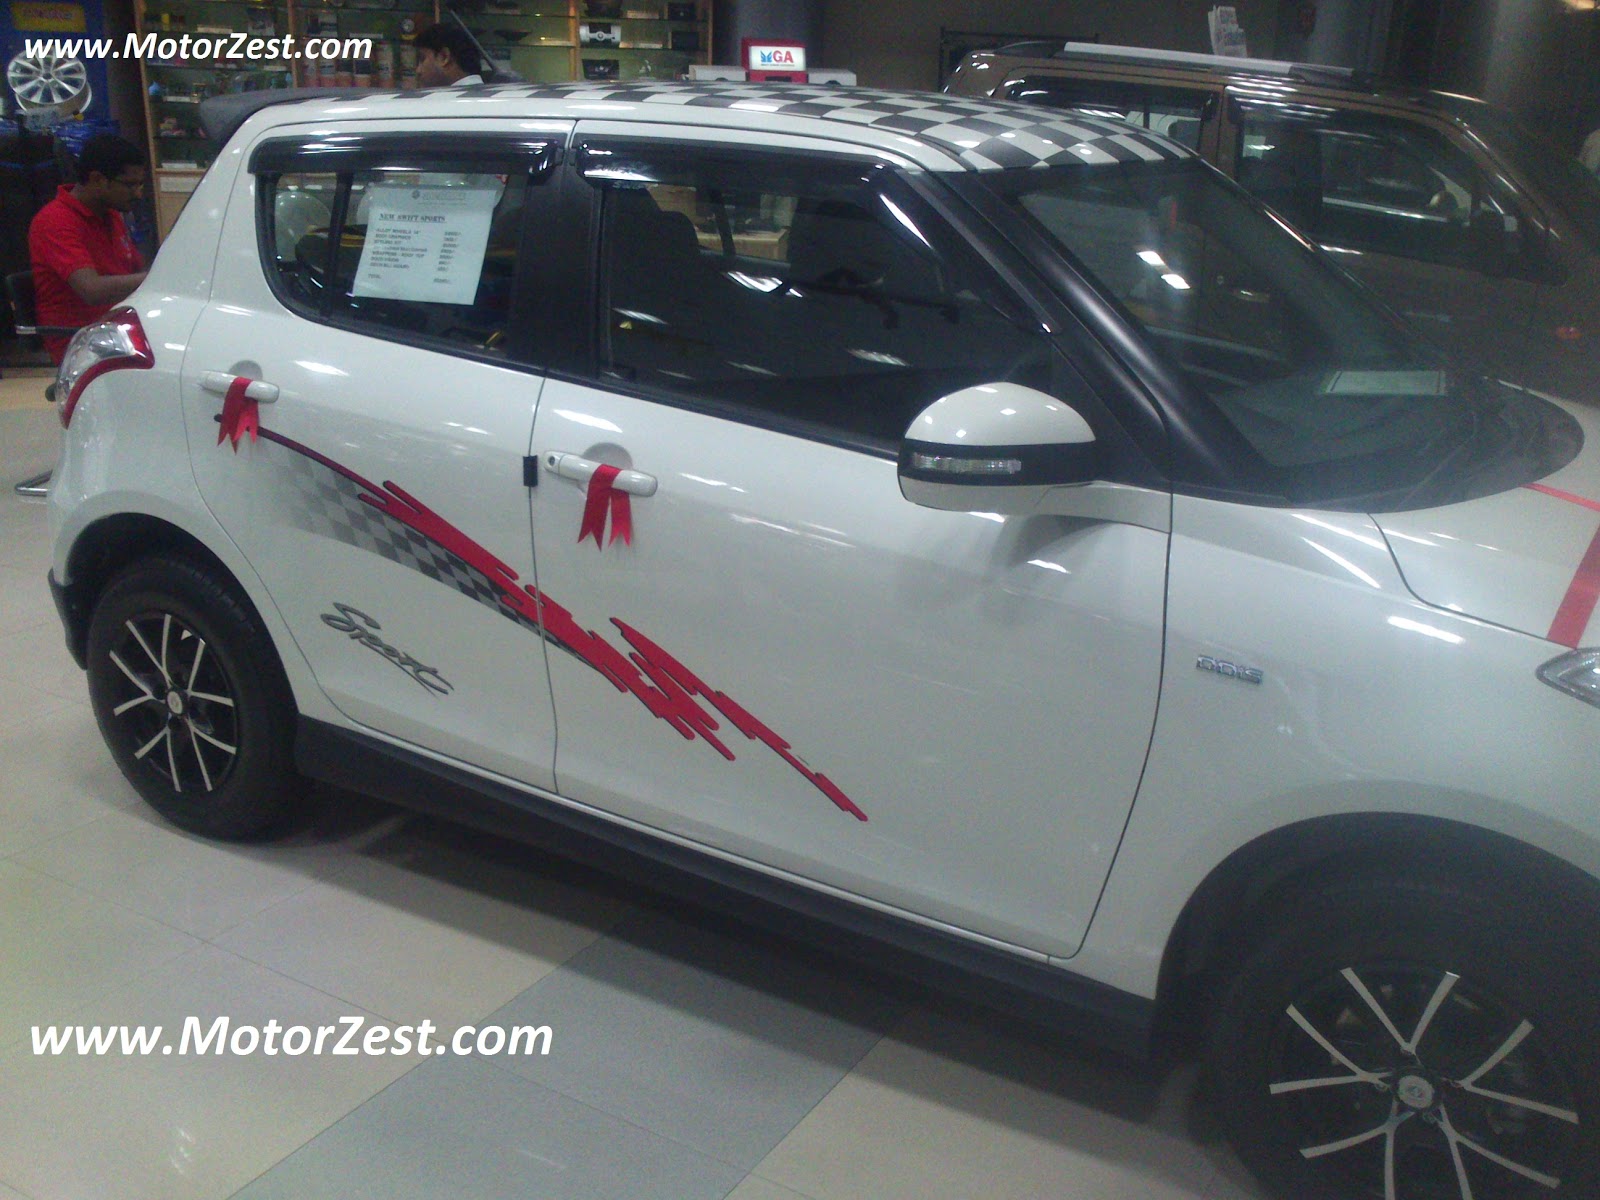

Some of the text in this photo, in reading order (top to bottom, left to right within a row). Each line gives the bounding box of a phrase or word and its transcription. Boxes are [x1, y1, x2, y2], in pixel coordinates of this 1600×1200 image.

[397, 214, 419, 222] SWIFT
[420, 215, 446, 223] SPORTS
[320, 602, 455, 699] Sport
